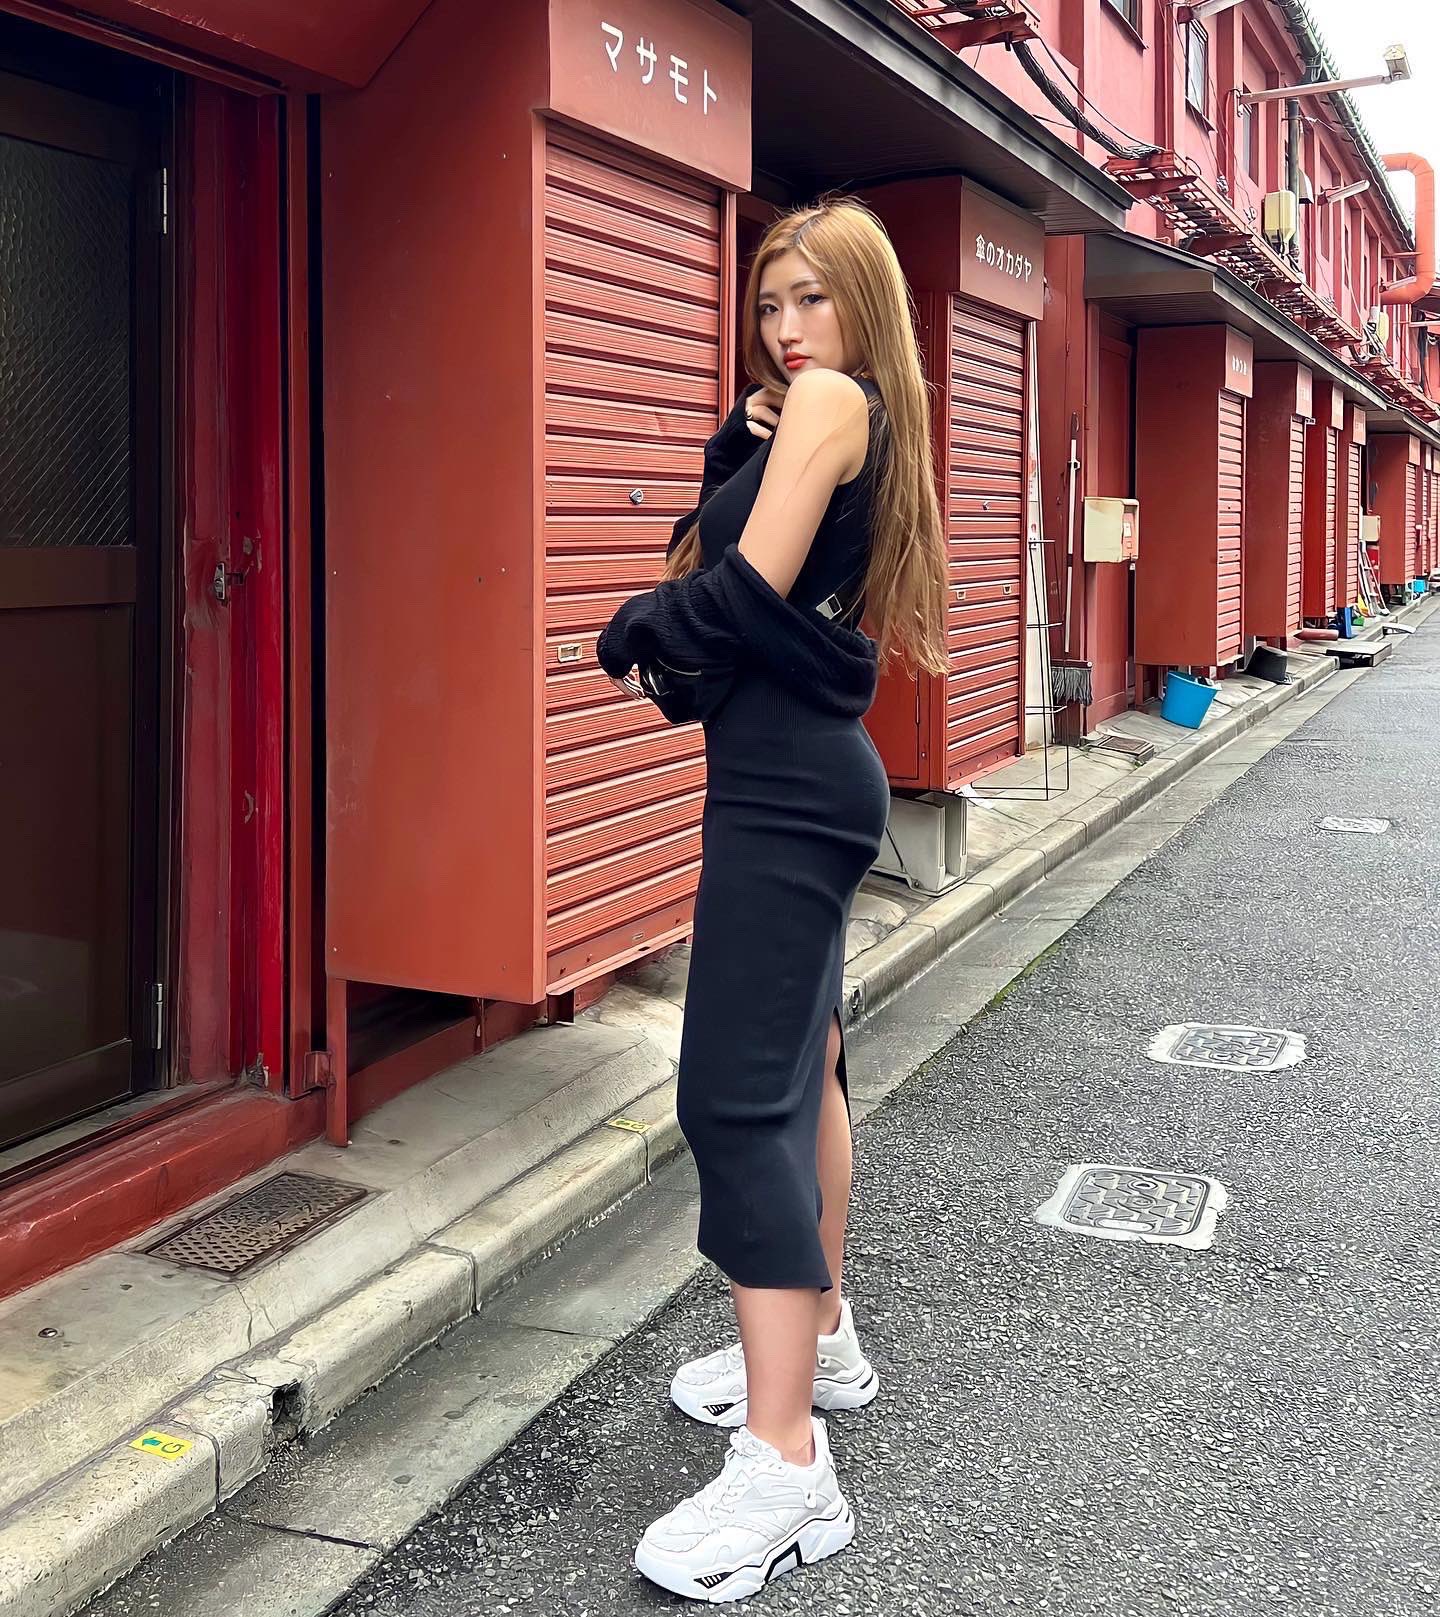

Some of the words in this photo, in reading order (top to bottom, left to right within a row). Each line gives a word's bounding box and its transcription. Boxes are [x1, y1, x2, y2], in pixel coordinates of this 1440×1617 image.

[601, 21, 718, 116] マサモト
[975, 233, 1033, 283] 傘のオカダヤ
[161, 1442, 184, 1454] G
